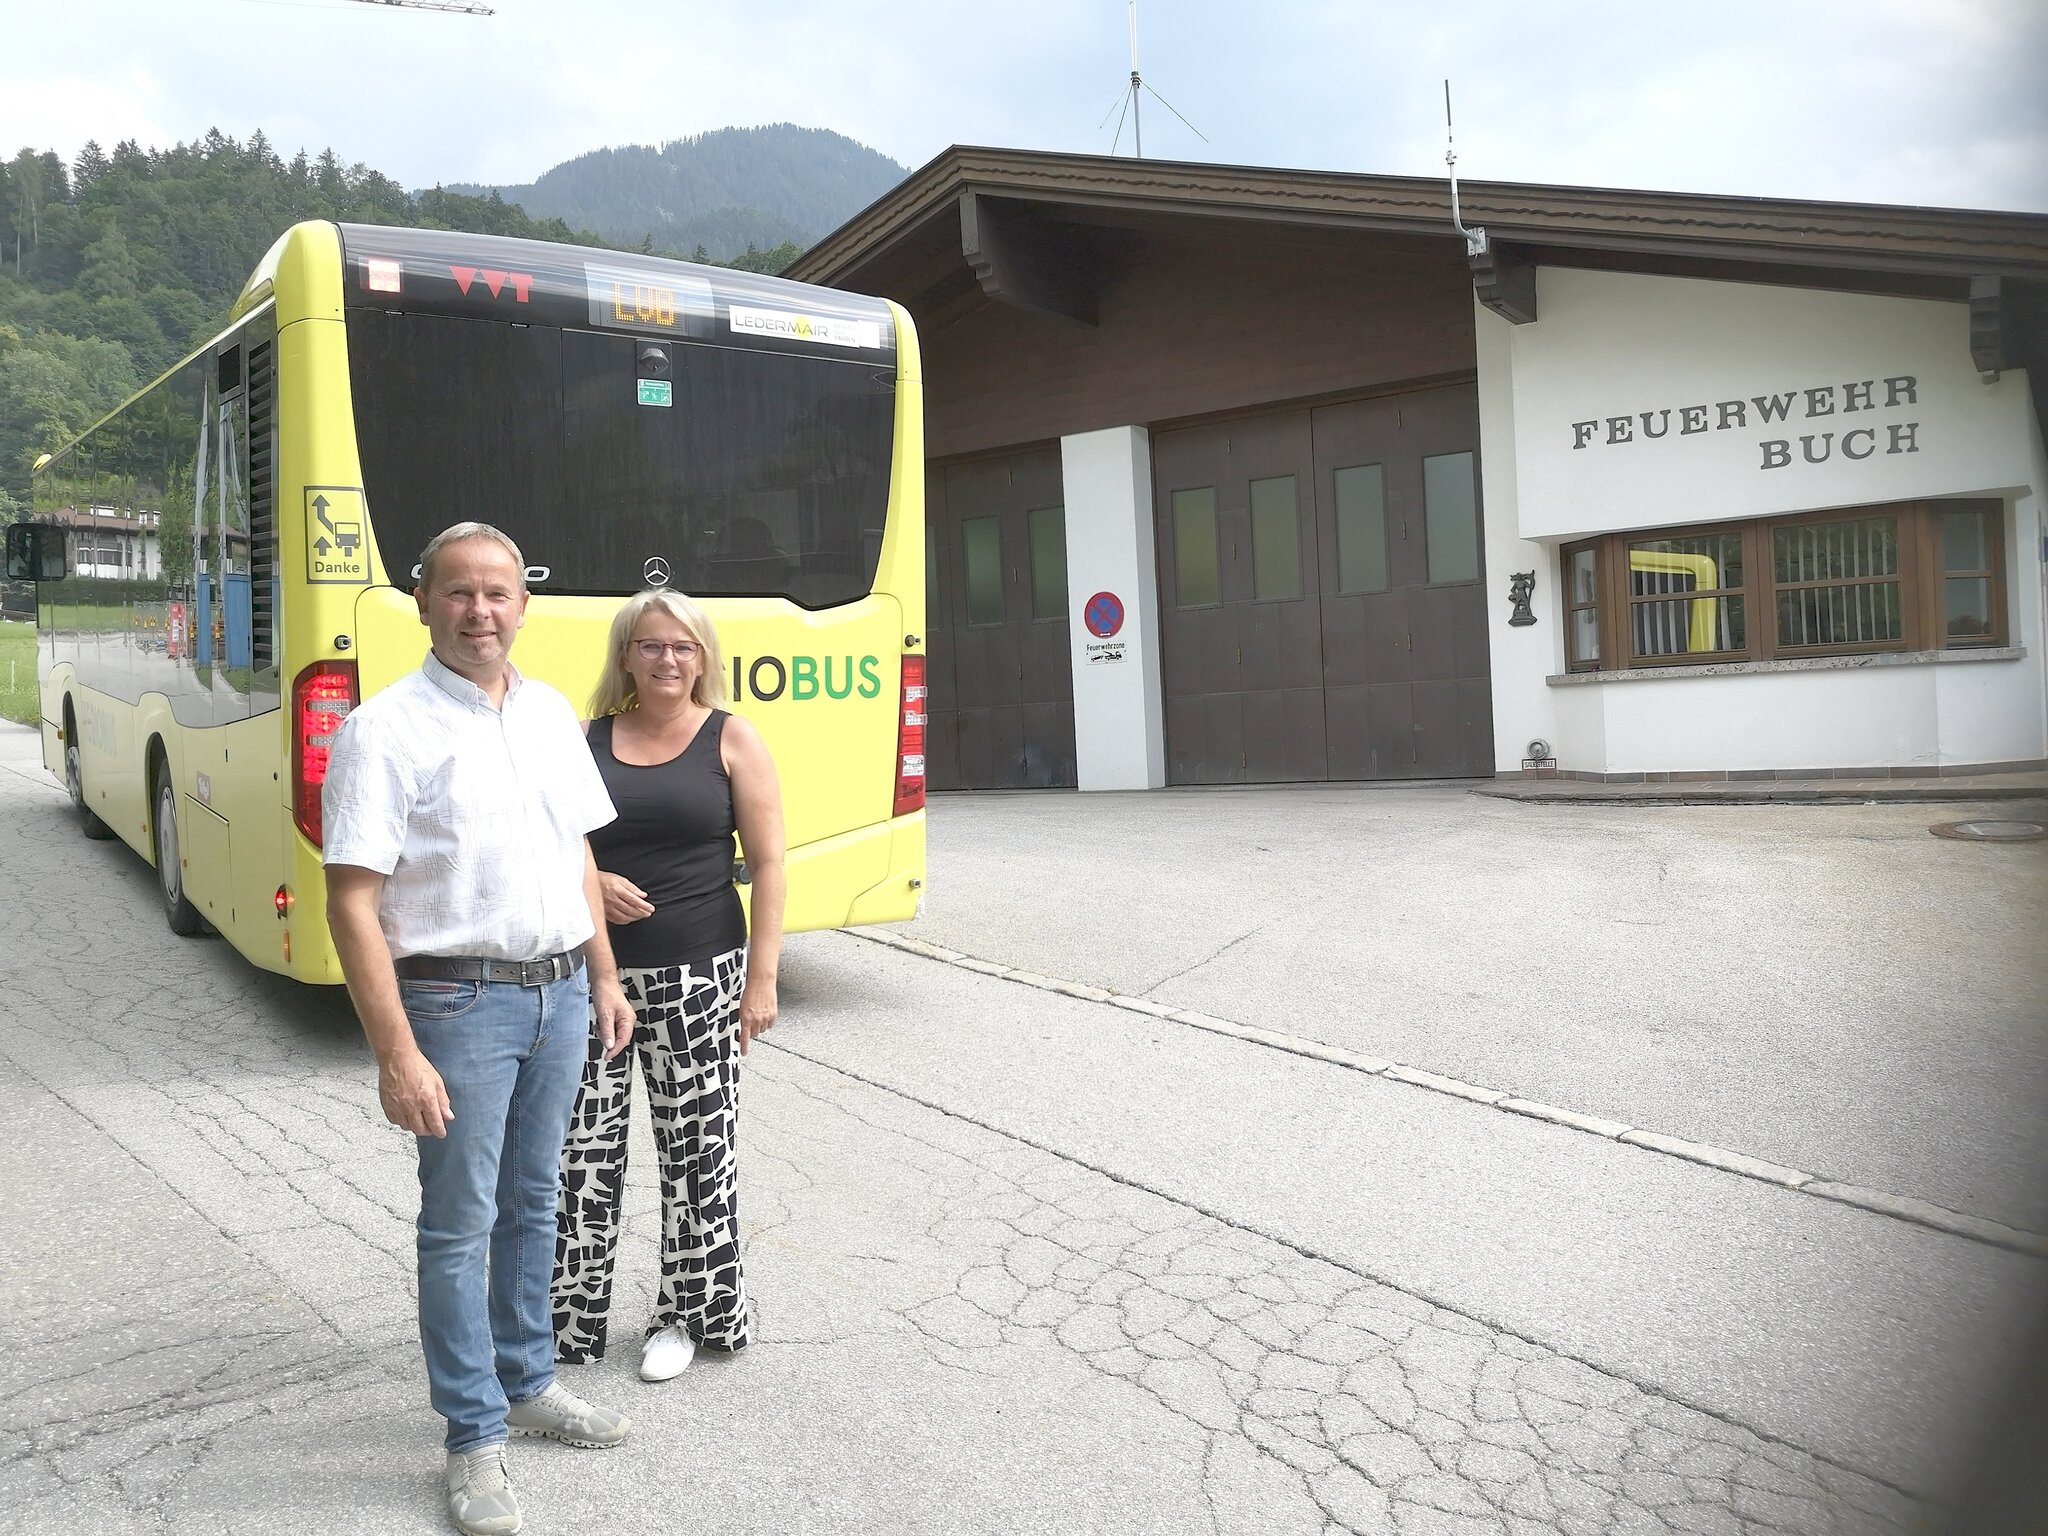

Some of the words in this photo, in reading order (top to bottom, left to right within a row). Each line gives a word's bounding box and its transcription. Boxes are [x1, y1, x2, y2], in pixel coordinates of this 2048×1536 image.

[734, 314, 829, 338] LEDERMAIR
[1571, 375, 1918, 450] FEUERWEHR
[1758, 422, 1920, 470] BUCH
[314, 561, 361, 573] Danke
[1086, 642, 1125, 651] Feuerwehrzone
[722, 654, 882, 702] IOBUS
